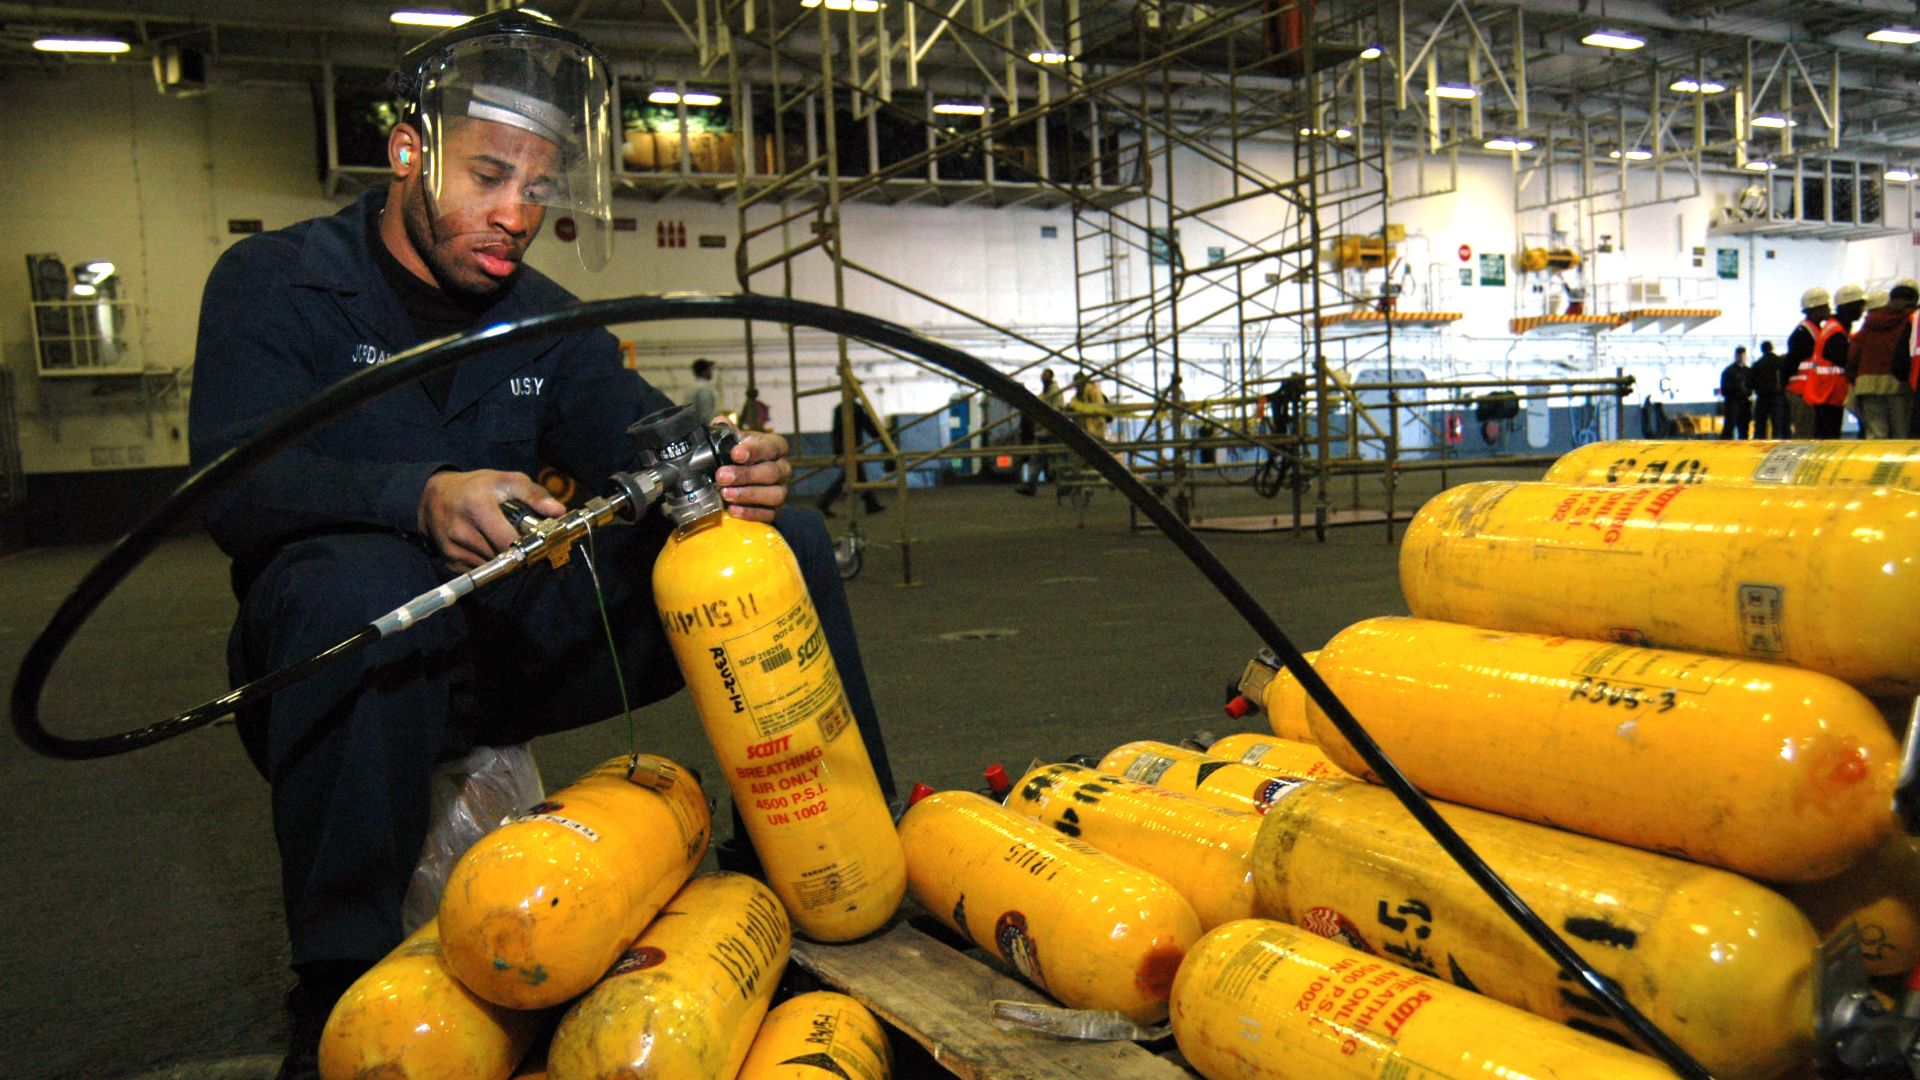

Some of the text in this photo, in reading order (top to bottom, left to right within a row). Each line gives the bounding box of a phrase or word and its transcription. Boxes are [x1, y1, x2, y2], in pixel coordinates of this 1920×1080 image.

[746, 734, 792, 760] SCOTT
[735, 745, 824, 779] BREATHING
[751, 765, 820, 795] AIR ONLY
[756, 782, 829, 811] 4500 P.S.I.
[767, 800, 829, 826] UN 1002
[1329, 958, 1359, 974] UN
[1342, 962, 1383, 985] 4500
[1367, 969, 1399, 987] AIR
[1295, 975, 1331, 1012] 1002
[1384, 990, 1432, 1036] SCOTT
